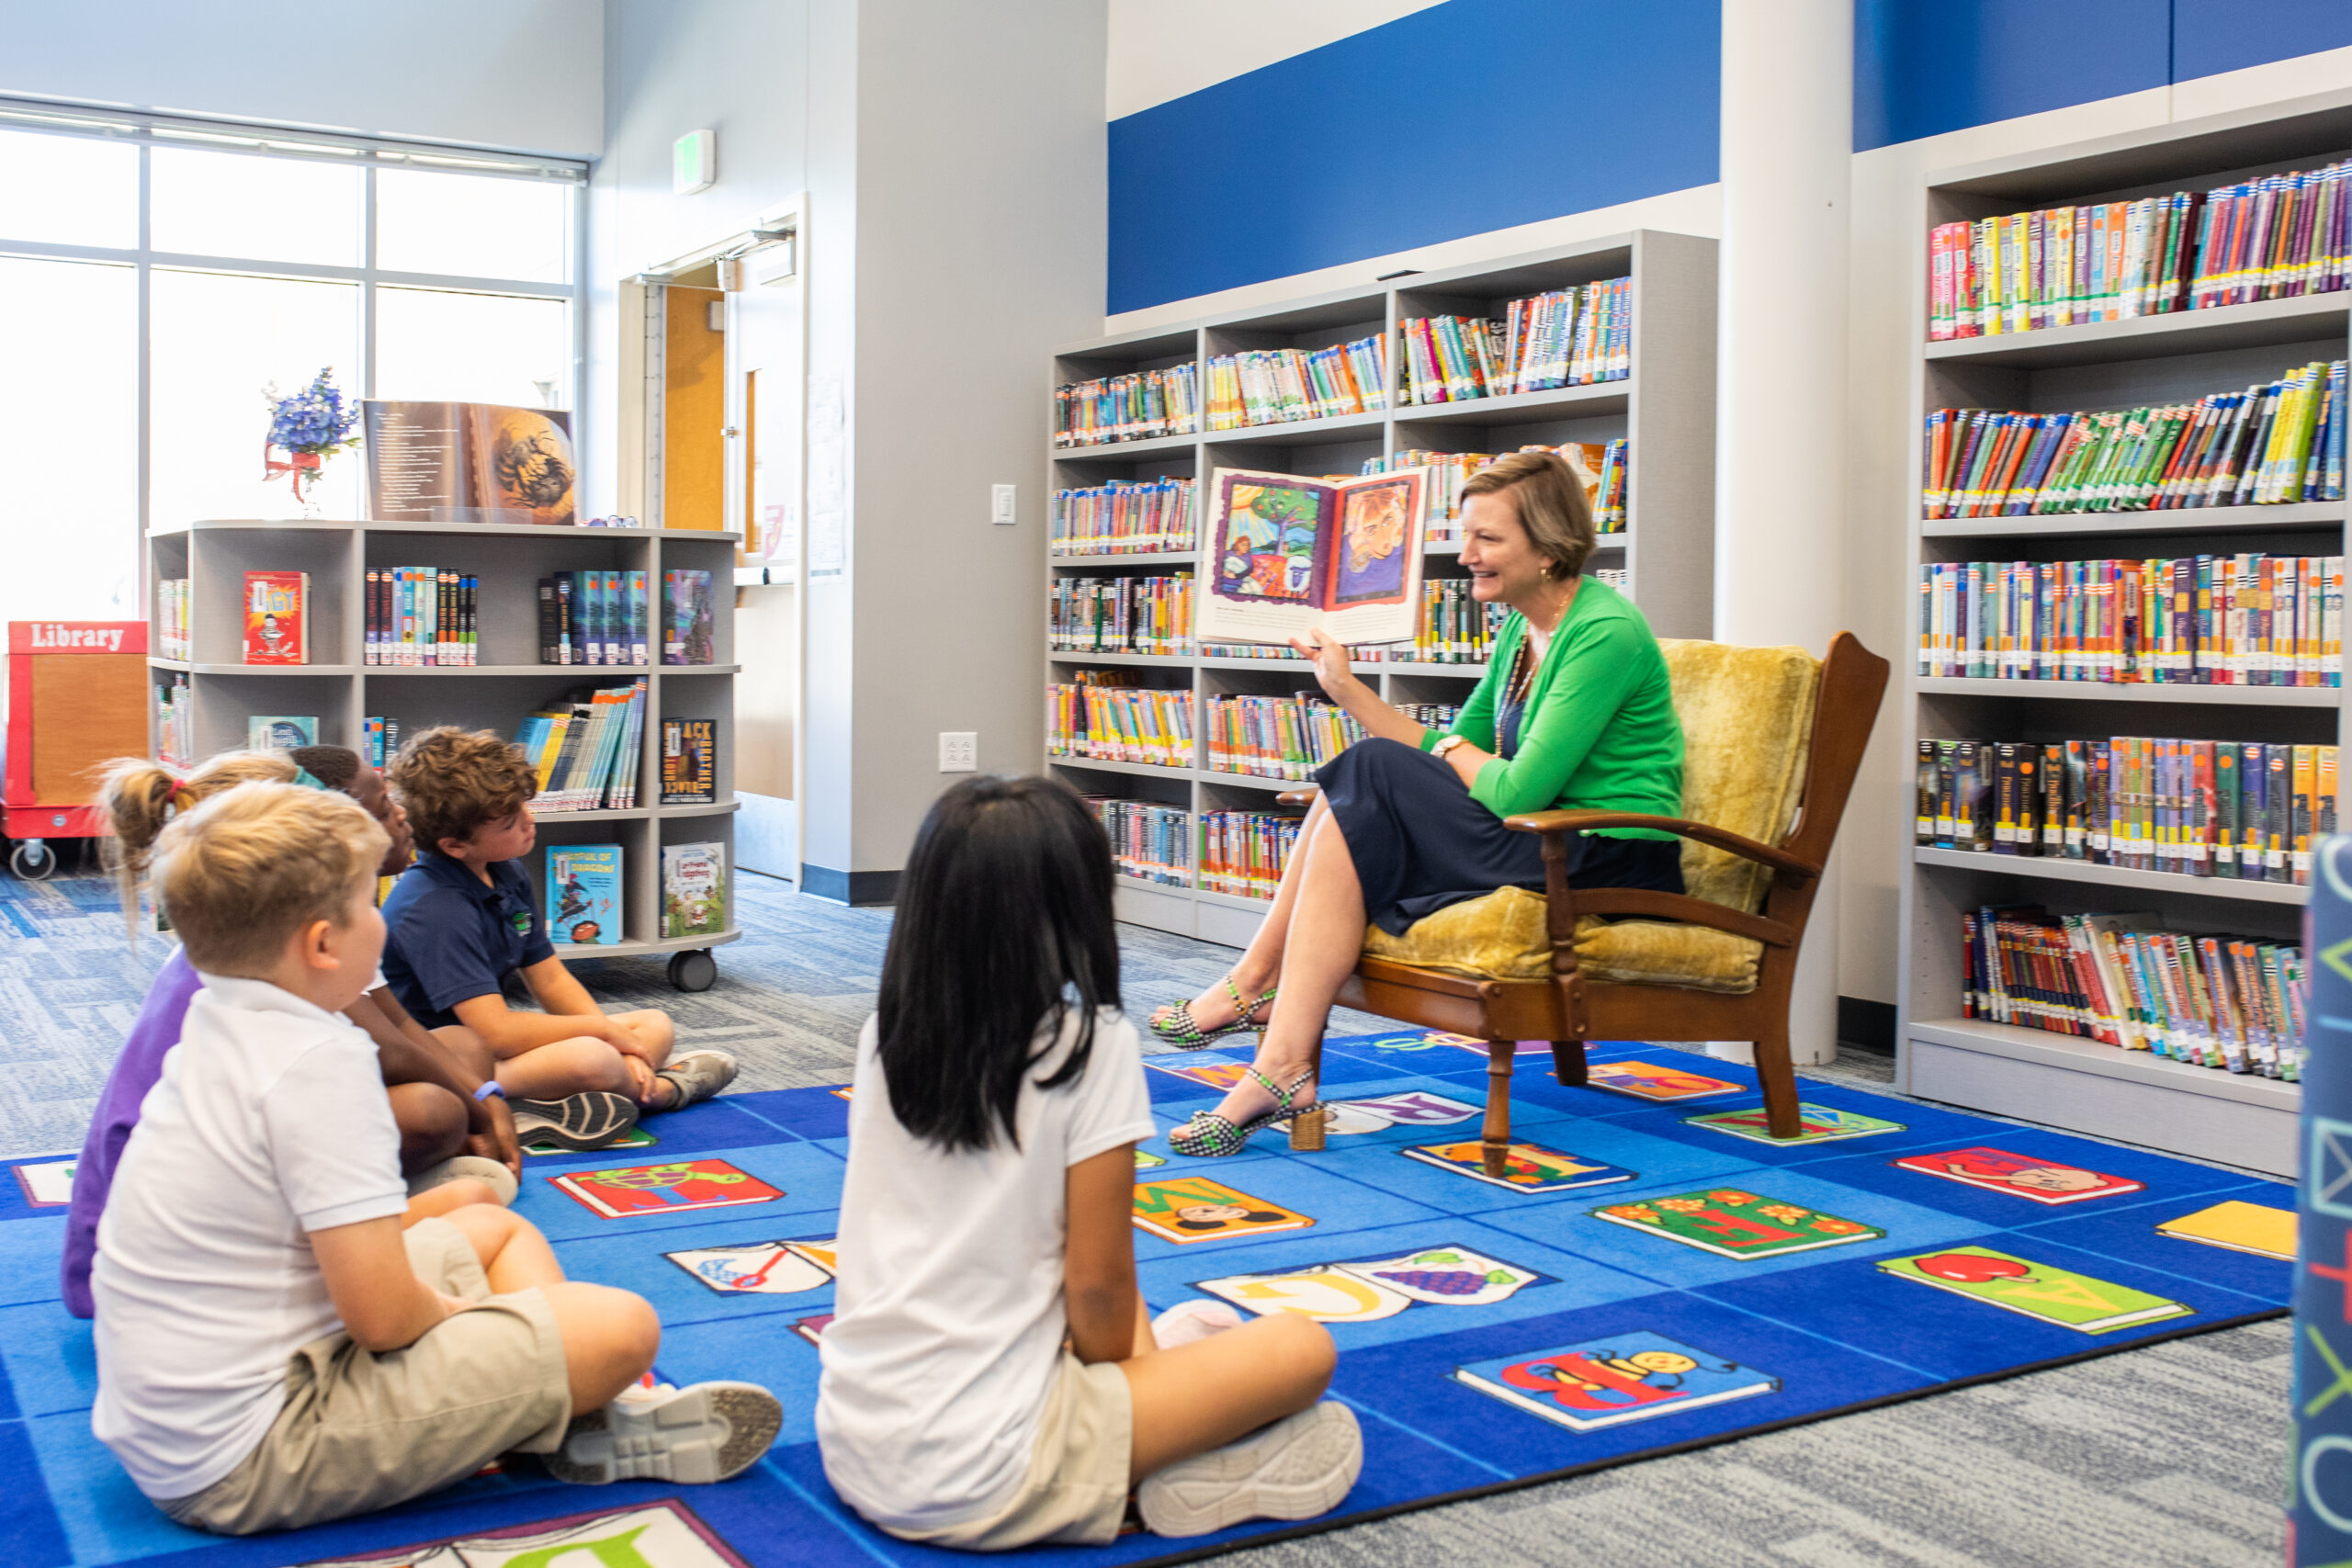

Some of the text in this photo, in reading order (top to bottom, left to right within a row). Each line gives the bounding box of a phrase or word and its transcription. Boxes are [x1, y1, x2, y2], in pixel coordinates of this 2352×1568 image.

[30, 624, 124, 651] Library
[663, 722, 712, 739] BACK
[1682, 1210, 1810, 1247] F
[1996, 1278, 2122, 1312] A
[1501, 1351, 1690, 1410] B
